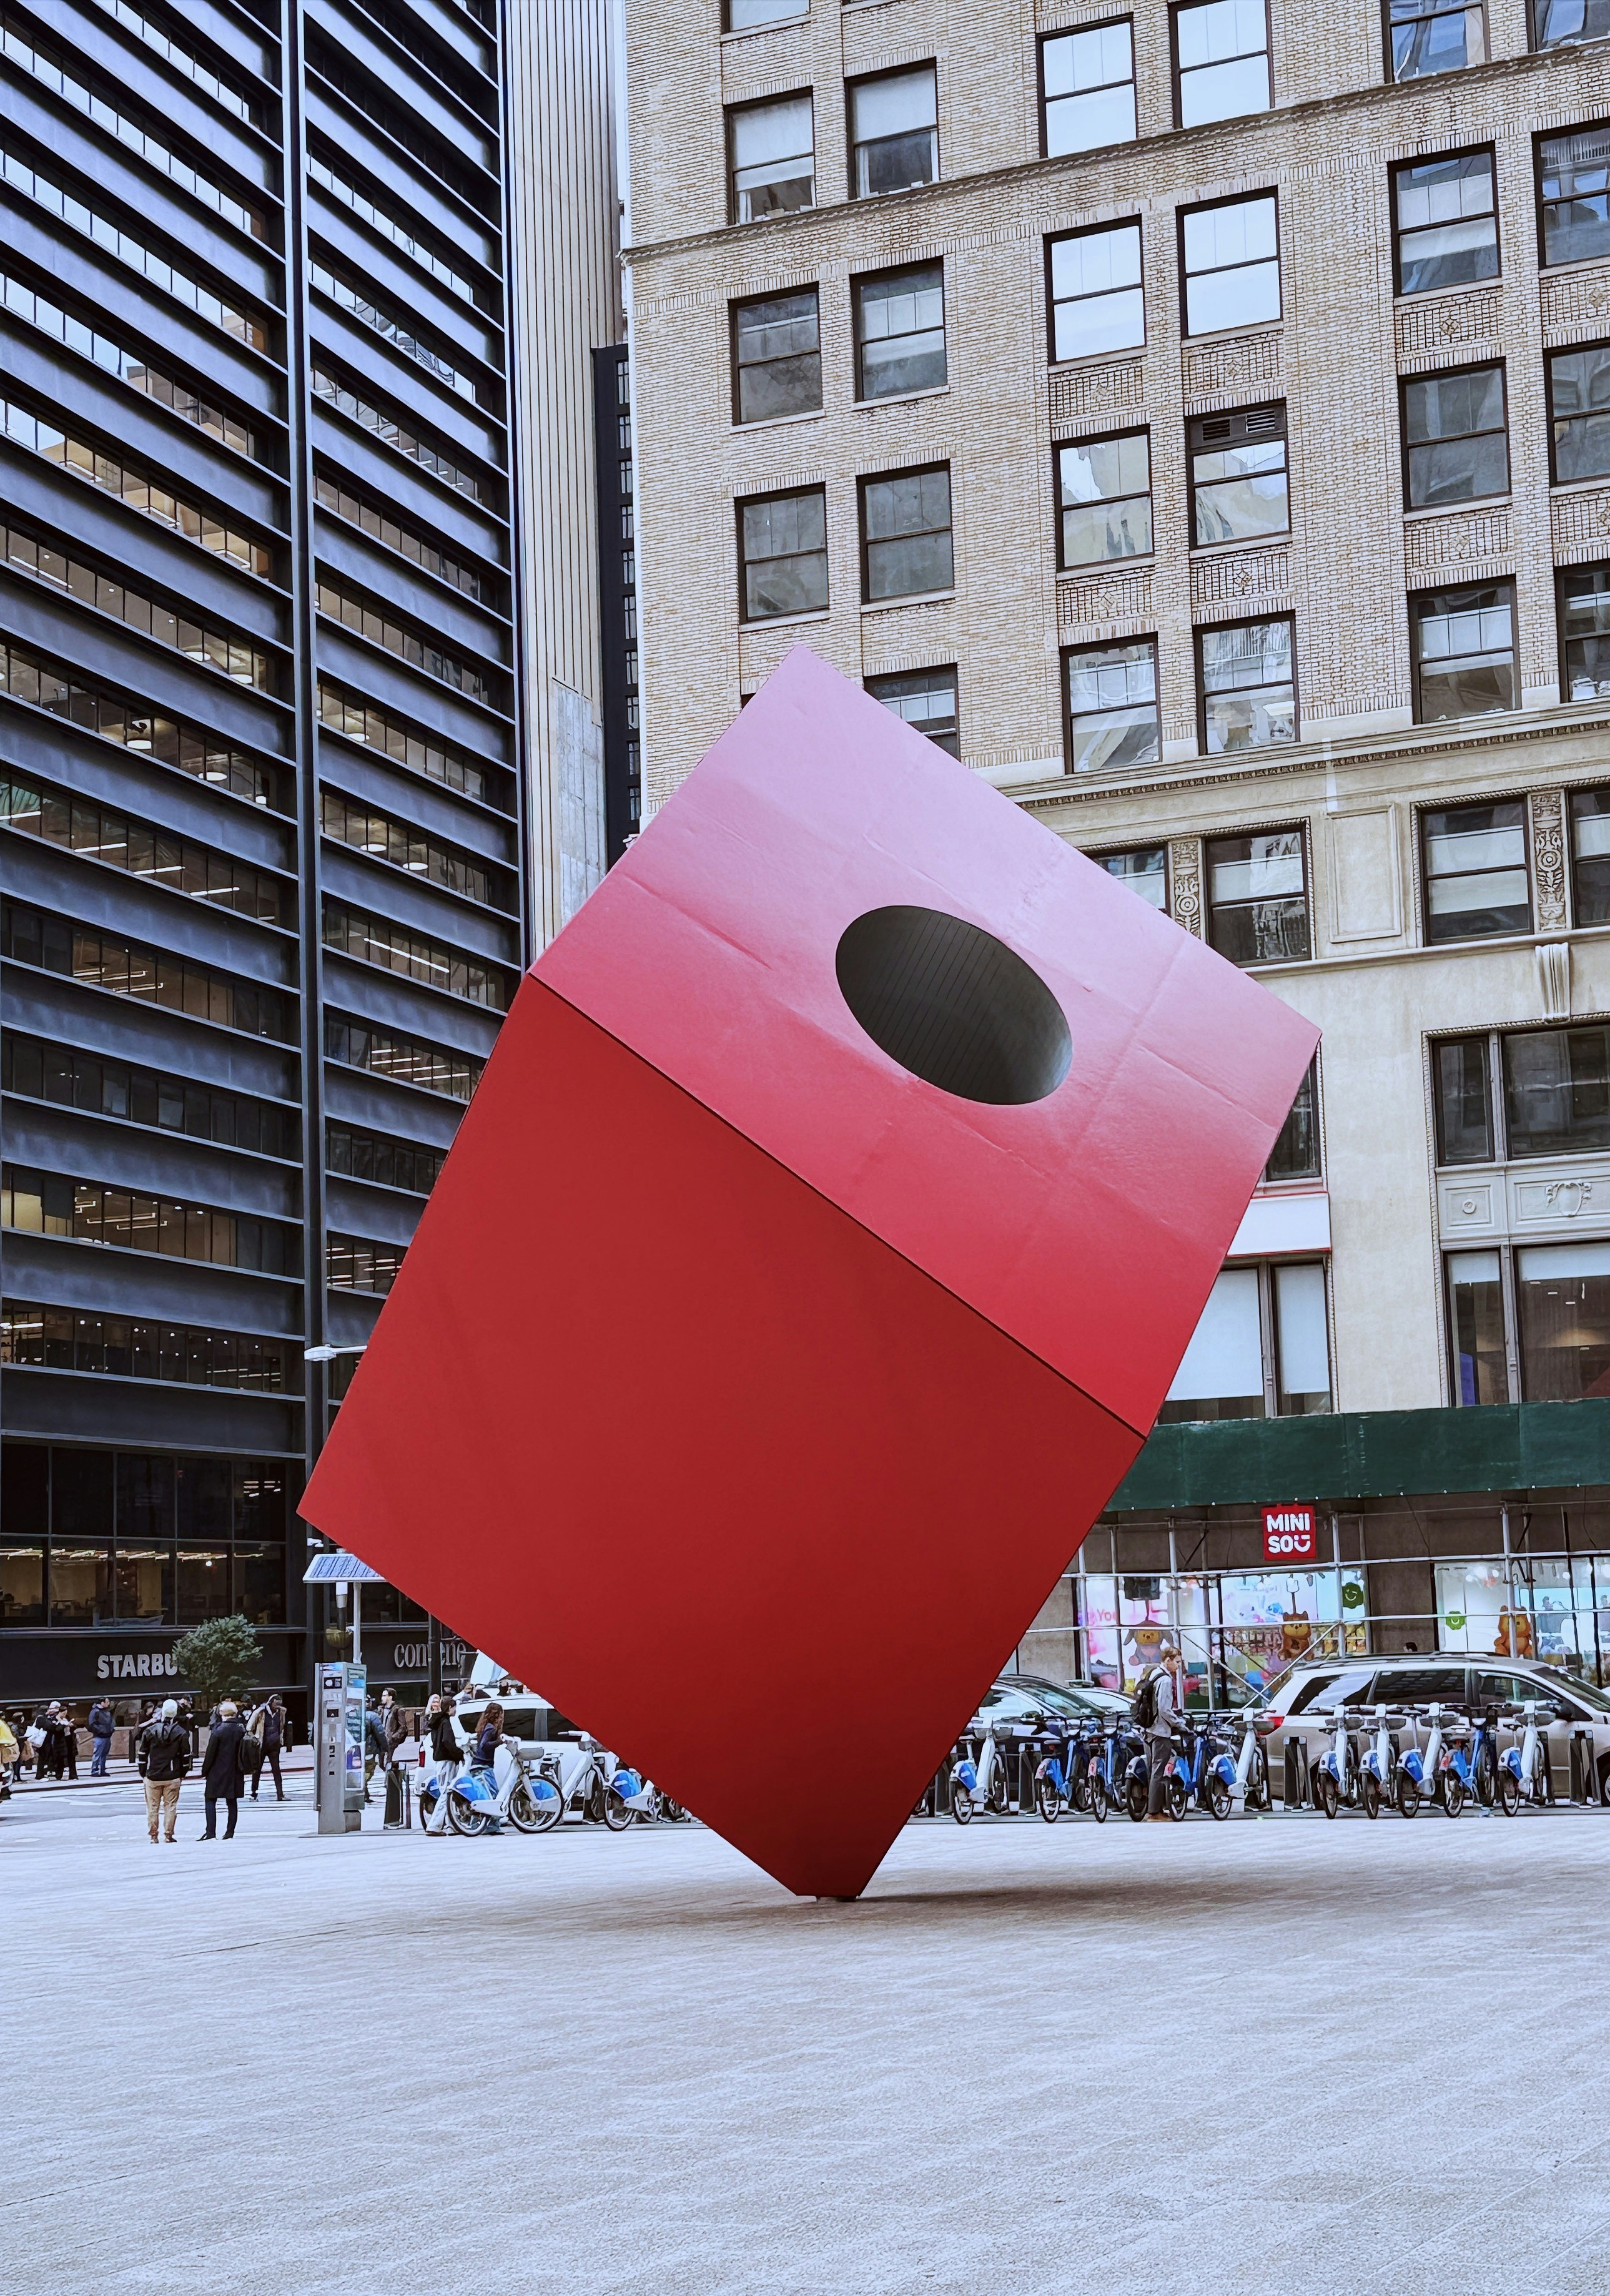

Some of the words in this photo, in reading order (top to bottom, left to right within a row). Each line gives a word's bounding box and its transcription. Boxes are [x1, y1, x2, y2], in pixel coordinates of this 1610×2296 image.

[1267, 1512, 1310, 1532] MINI
[97, 1653, 187, 1679] STARBU
[394, 1642, 467, 1668] conne
